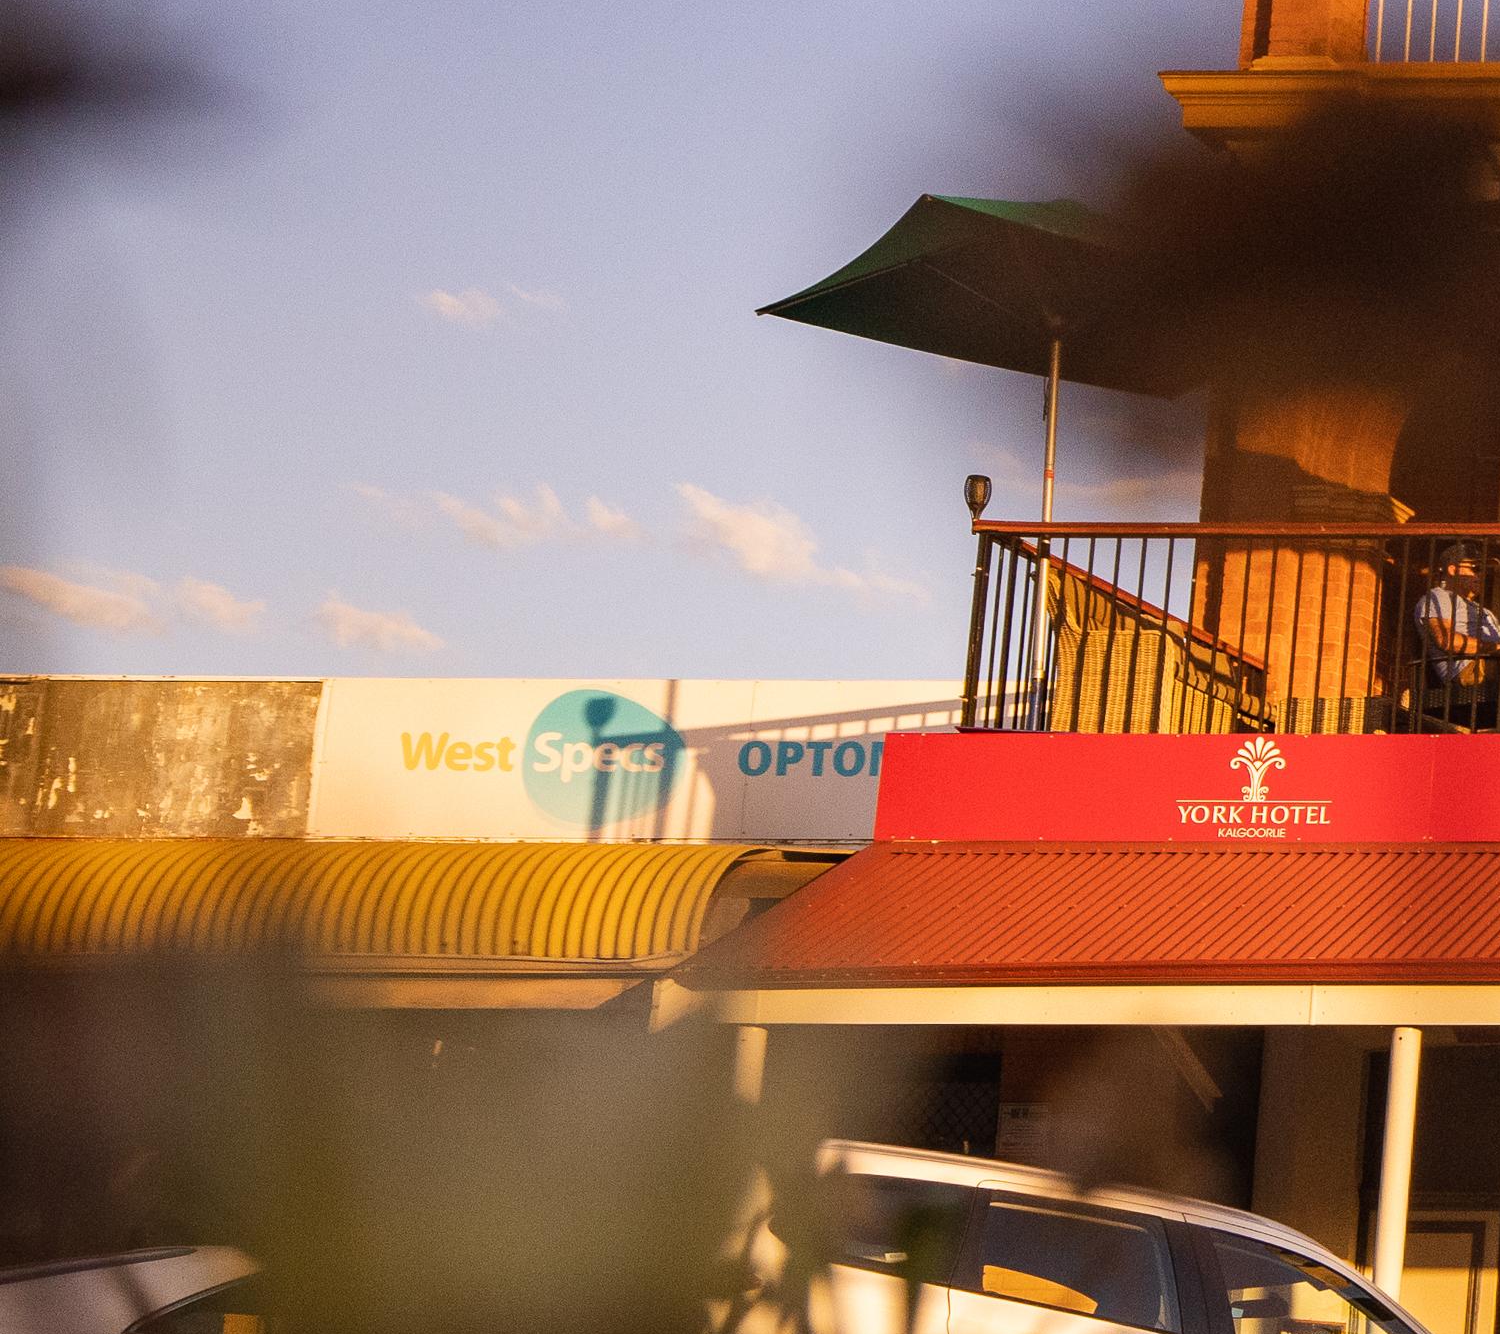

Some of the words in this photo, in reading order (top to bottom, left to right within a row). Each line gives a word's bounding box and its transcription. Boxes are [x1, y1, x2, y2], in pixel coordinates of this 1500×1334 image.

[401, 733, 516, 772] West
[532, 731, 666, 783] Specs
[1177, 805, 1245, 824] YORK
[1251, 805, 1332, 825] HOTEL
[1217, 827, 1287, 838] KALGOORLIE
